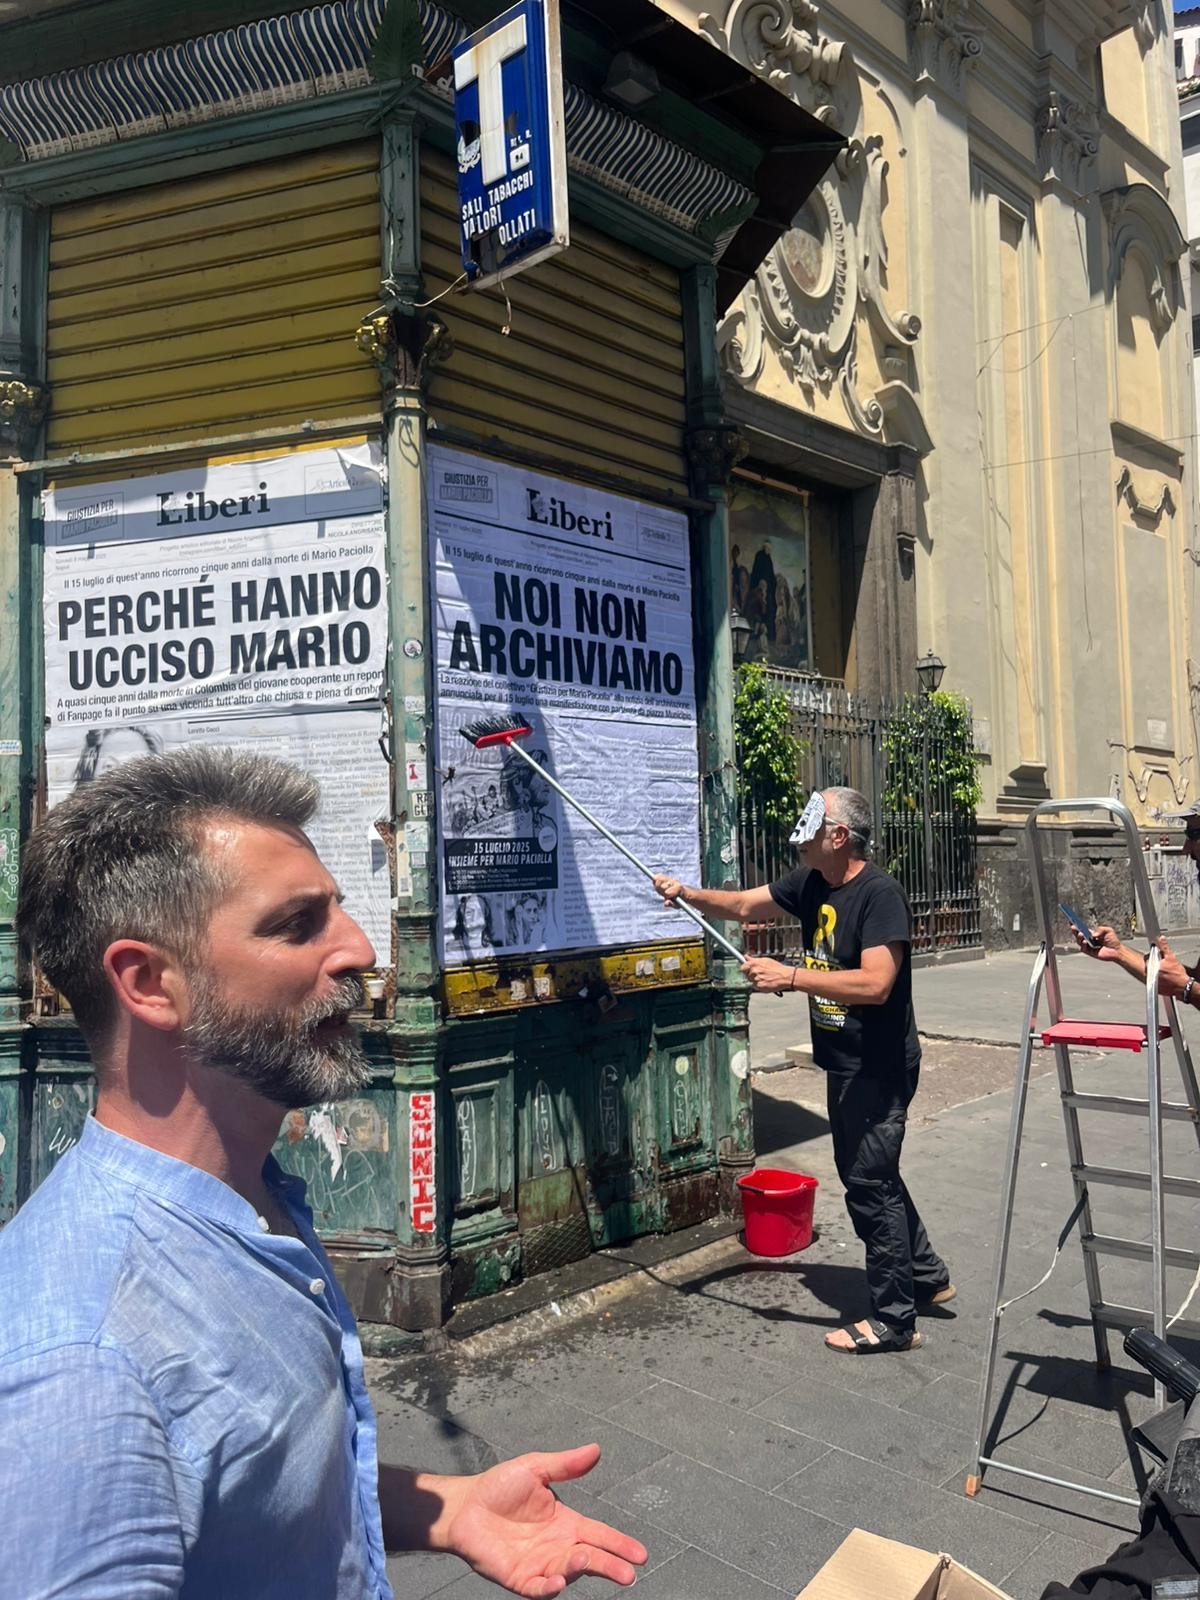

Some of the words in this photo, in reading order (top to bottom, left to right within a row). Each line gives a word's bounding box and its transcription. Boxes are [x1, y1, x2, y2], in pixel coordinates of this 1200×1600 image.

[454, 13, 528, 187] T
[461, 196, 483, 220] SALI
[488, 170, 534, 204] TABACCHI
[462, 205, 502, 241] VALORI
[498, 208, 536, 245] OLLATI
[444, 472, 476, 486] GIUSTIZIA
[476, 475, 489, 487] PER
[67, 503, 100, 523] GIUSTIZIA
[100, 498, 114, 513] PER
[156, 481, 271, 527] Liberi
[526, 488, 614, 541] Liberi
[64, 579, 69, 589] Il
[71, 578, 81, 588] 15
[82, 574, 105, 588] luglio
[106, 573, 114, 584] di
[115, 568, 160, 584] quest'anno
[161, 563, 199, 577] ricorrono
[201, 560, 229, 575] cinque
[230, 559, 250, 569] anni
[251, 555, 272, 567] dalla
[274, 553, 299, 565] morte
[301, 550, 310, 561] di
[312, 548, 337, 560] Mario
[339, 544, 374, 557] Paciolla
[445, 545, 451, 556] Il
[453, 547, 462, 557] 15
[463, 549, 484, 562] luglio
[485, 553, 493, 564] di
[494, 555, 532, 572] quest'anno
[533, 563, 564, 578] ricorrono
[564, 570, 586, 584] cinque
[587, 575, 600, 585] anni
[601, 577, 616, 589] dalla
[617, 582, 634, 593] morte
[635, 584, 641, 594] di
[642, 585, 658, 598] Mario
[658, 590, 680, 602] Paciolla
[58, 574, 216, 641] PERCHÉ
[231, 566, 382, 623] HANNO
[493, 571, 562, 629] NOI
[574, 587, 647, 643] NON
[69, 637, 215, 691] UCCISO
[229, 621, 371, 675] MARIO
[449, 619, 683, 696] ARCHIVIAMO
[57, 698, 63, 708] A
[65, 696, 87, 710] quasi
[88, 694, 116, 708] cinque
[118, 692, 137, 703] anni
[137, 690, 158, 701] dalla
[160, 687, 184, 699] morte
[185, 685, 193, 696] in
[194, 681, 236, 696] Colombia
[238, 679, 251, 690] del
[253, 678, 289, 692] giovane
[290, 674, 341, 687] cooperante
[343, 673, 355, 682] un
[356, 670, 385, 683] report
[57, 711, 66, 722] di
[67, 709, 102, 723] Fanpage
[104, 708, 113, 718] fa
[115, 707, 120, 717] il
[122, 705, 146, 718] punto
[148, 704, 159, 714] su
[161, 703, 177, 712] una
[180, 698, 214, 711] vicenda
[216, 693, 254, 706] tutt'altro
[256, 692, 272, 703] che
[274, 690, 304, 701] chiusa
[307, 689, 313, 699] e
[315, 687, 341, 700] piena
[343, 685, 353, 697] di
[440, 673, 450, 684] La
[450, 674, 482, 688] reazione
[482, 678, 494, 689] del
[494, 679, 526, 692] collettivo
[558, 686, 568, 697] per
[568, 688, 587, 698] Mario
[440, 687, 483, 701] annunciata
[484, 692, 497, 703] per
[498, 692, 503, 702] il
[505, 693, 514, 703] 15
[514, 695, 534, 707] luglio
[535, 697, 548, 707] una
[549, 699, 597, 711] manifestazione
[598, 703, 610, 713] con
[637, 707, 646, 716] da
[646, 708, 664, 718] piazza
[665, 709, 692, 720] Municipio
[448, 854, 479, 867] INSIEME
[479, 855, 495, 867] PER
[495, 854, 519, 866] MARIO
[520, 853, 553, 865] PACIOLLA
[474, 842, 483, 854] 15
[485, 841, 511, 854] LUGLIO
[512, 841, 531, 853] 2025
